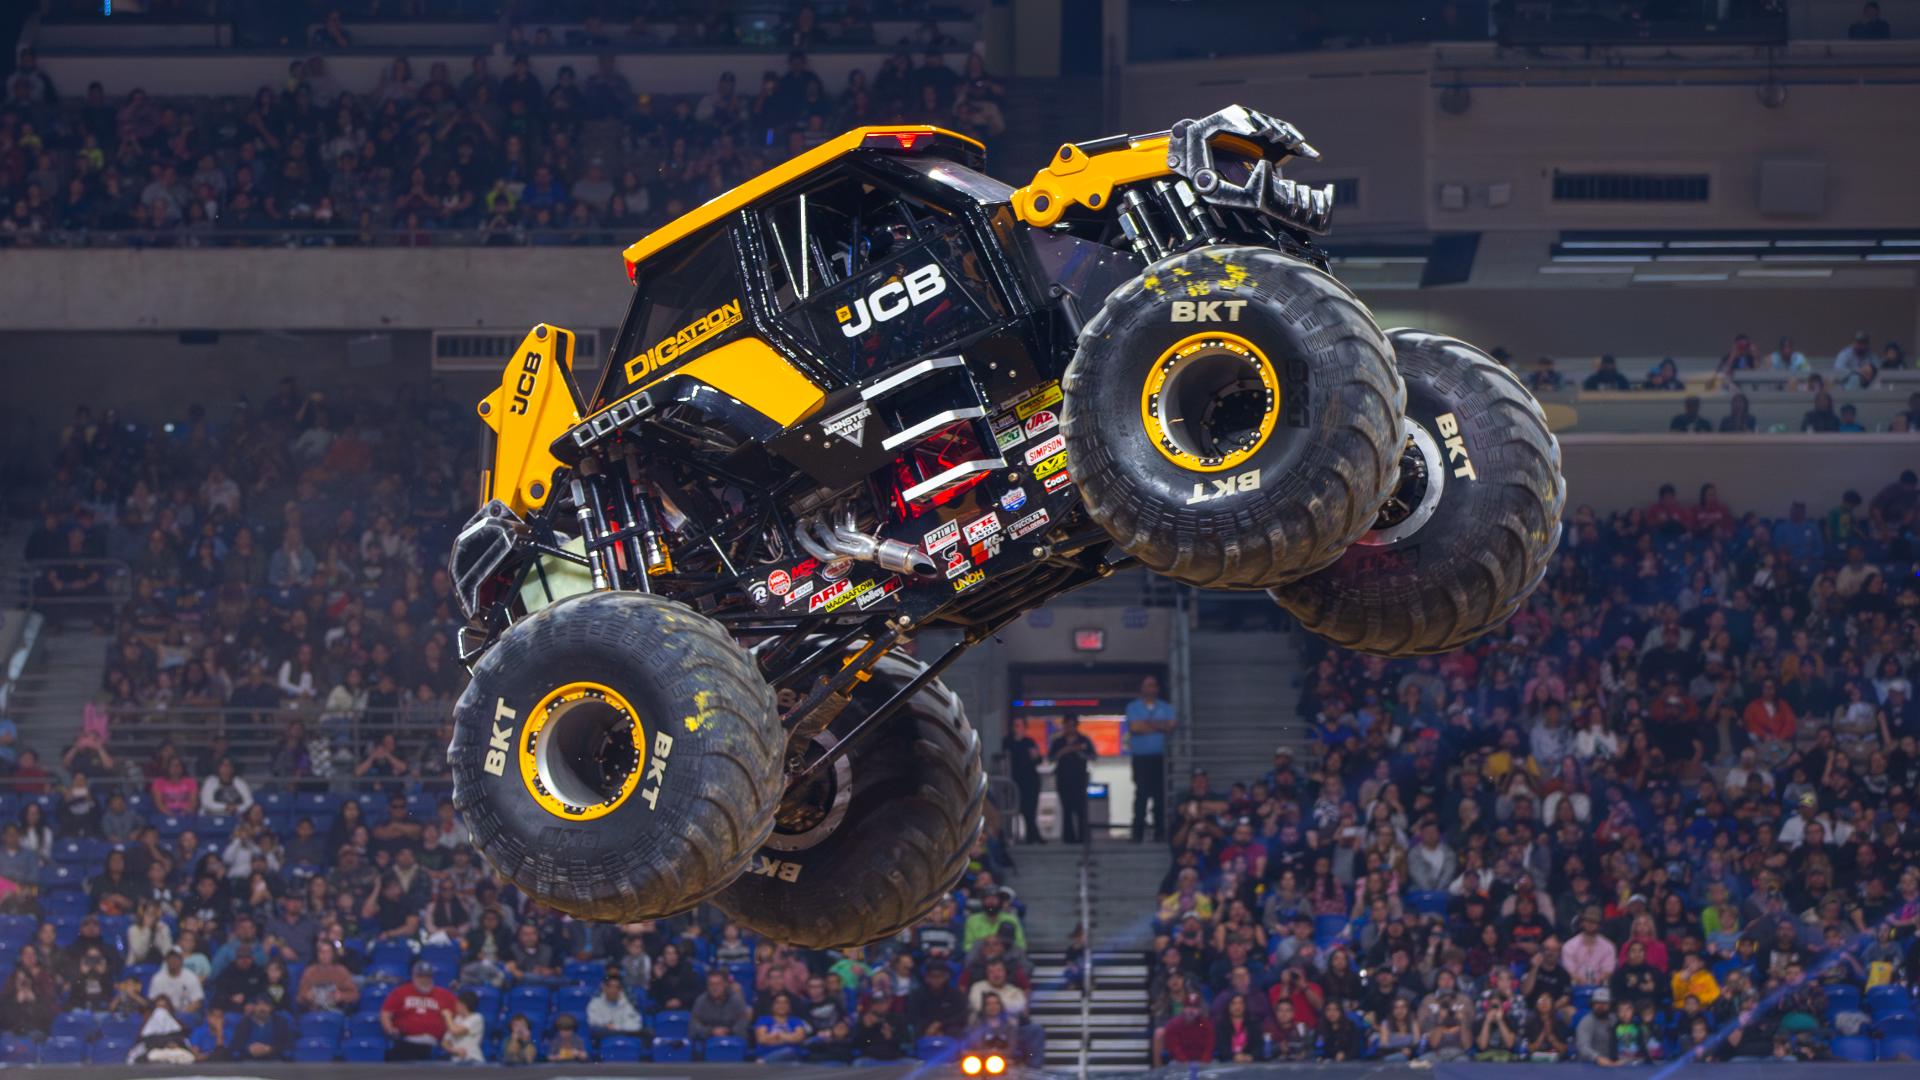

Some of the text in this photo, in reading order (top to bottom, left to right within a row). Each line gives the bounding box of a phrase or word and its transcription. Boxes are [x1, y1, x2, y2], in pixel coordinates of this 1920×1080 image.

[842, 264, 946, 338] JCB
[1171, 300, 1248, 322] BKT
[624, 298, 741, 385] DIGATRON
[510, 351, 541, 416] JCB
[823, 408, 872, 436] MONSTER
[842, 420, 863, 437] JAM
[1029, 438, 1063, 462] SIMPSON
[1435, 412, 1476, 481] BKT
[1044, 474, 1068, 488] Coan
[1186, 469, 1261, 505] BKT
[927, 524, 956, 544] OPTIMA
[1010, 511, 1041, 533] LINCOLN
[811, 579, 849, 609] ARP
[953, 568, 985, 591] UNOH
[826, 580, 874, 609] MAGNAFLOW
[484, 697, 517, 777] BKT
[641, 731, 674, 811] BKT
